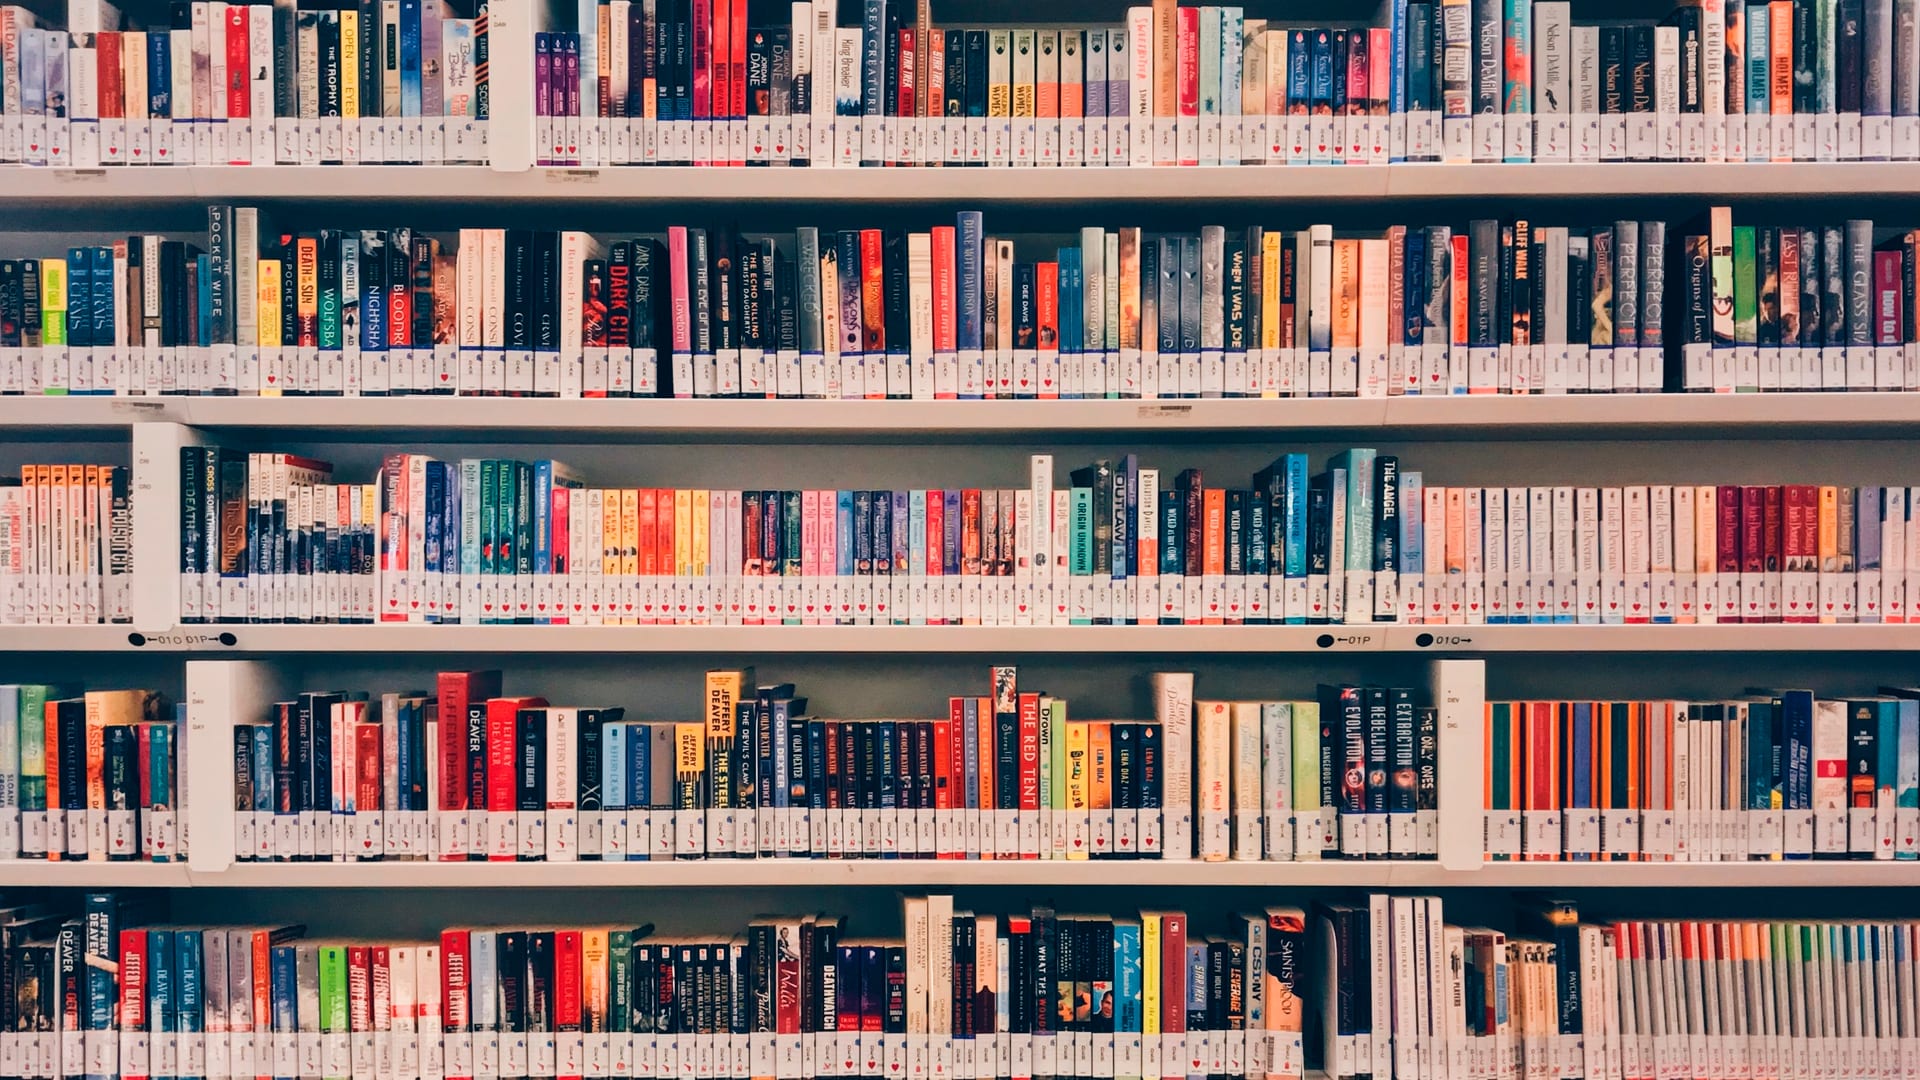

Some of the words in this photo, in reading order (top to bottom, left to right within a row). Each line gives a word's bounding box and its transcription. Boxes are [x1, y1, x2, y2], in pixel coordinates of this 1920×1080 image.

[4, 10, 15, 31] BILL
[364, 13, 372, 43] Fallen
[868, 7, 877, 32] SEA
[1751, 10, 1765, 58] WARLOCK
[4, 34, 15, 63] DALY
[345, 29, 355, 58] OPEN
[838, 39, 854, 56] King
[1480, 20, 1498, 55] Nelson
[1546, 23, 1560, 51] Nelson
[364, 47, 372, 80] Women
[677, 44, 685, 65] Dane
[750, 53, 761, 86] DANE
[773, 45, 783, 80] DANE
[903, 50, 913, 69] STAR
[933, 50, 942, 69] STAR
[1546, 54, 1560, 86] DeMille
[1707, 23, 1722, 86] CRUCIBLE
[328, 63, 336, 105] TROPHY
[842, 58, 854, 88] Breaker
[868, 39, 877, 114] CREATURE
[903, 70, 913, 88] TREK
[933, 70, 942, 89] TREK
[1480, 59, 1498, 99] DeMille
[1751, 60, 1765, 99] HOLMES
[345, 87, 355, 115] EYES
[991, 86, 1001, 117] WOMEN
[1016, 86, 1025, 117] WOMEN
[212, 212, 221, 272] POCKET
[1516, 220, 1528, 248] CLIFF
[1783, 234, 1797, 265] LAST
[302, 246, 315, 275] DEATH
[1393, 232, 1402, 269] LYDIA
[1516, 250, 1528, 279] WALK
[1232, 251, 1243, 282] WHEN
[1691, 255, 1704, 300] Origins
[212, 280, 221, 317] WIFE
[285, 263, 293, 311] POCKET
[302, 284, 315, 304] SUN
[1393, 273, 1402, 309] DAVIS
[1620, 242, 1635, 326] PERFECT
[1646, 243, 1661, 326] PERFECT
[1853, 270, 1867, 317] GLASS
[323, 288, 335, 347] WOLFSBA
[743, 289, 751, 335] DAUGHERTY
[1232, 292, 1243, 320] WAS
[1693, 302, 1705, 313] of
[1882, 290, 1896, 317] how
[285, 313, 293, 340] WIFE
[676, 298, 686, 343] Lovetorn
[751, 302, 759, 339] KILLING
[1230, 323, 1243, 347] JOE
[1694, 315, 1703, 342] Love
[1883, 320, 1896, 333] to
[206, 465, 214, 491] CROSS
[1383, 461, 1395, 482] THE
[186, 489, 196, 529] DEATH
[1076, 503, 1087, 530] ORIGIN
[1114, 475, 1125, 542] OUTLAW
[1252, 507, 1263, 528] WICKED
[1383, 484, 1395, 520] ANGEL
[1489, 505, 1503, 527] Jude
[1511, 505, 1525, 527] Jude
[1582, 506, 1595, 527] Jude
[1655, 500, 1669, 521] Jude
[112, 509, 127, 548] POISON
[1655, 523, 1669, 565] Deveraux
[112, 552, 127, 574] CIT
[1076, 532, 1087, 571] UNKNOWN
[1489, 529, 1503, 570] Deveraux
[1511, 529, 1525, 570] Deveraux
[1582, 530, 1595, 571] Deveraux
[186, 636, 208, 645] 01P
[1348, 636, 1371, 644] 01P
[300, 709, 309, 737] Home
[711, 690, 720, 732] DEAVER
[720, 689, 730, 733] JEFFERY
[742, 710, 750, 727] THE
[1023, 701, 1036, 728] THE
[1041, 707, 1051, 745] Drown
[491, 720, 502, 765] DEAVER
[503, 720, 512, 766] JEFFERY
[775, 713, 785, 744] COLIN
[792, 734, 803, 753] COLIN
[1345, 706, 1362, 762] EVOLUTION
[1370, 706, 1387, 762] REBELLION
[1395, 703, 1413, 765] EXTRACTION
[300, 739, 309, 762] Fires
[556, 730, 567, 765] JEFFERY
[742, 730, 750, 759] DEVIL'S
[1023, 735, 1036, 761] RED
[718, 751, 729, 773] THE
[742, 762, 750, 784] CLAW
[775, 747, 785, 788] DEXTER
[792, 754, 803, 778] DEXTER
[6, 774, 14, 805] SLOANE
[556, 768, 567, 799] DEAVER
[718, 775, 729, 807] STEEL
[1023, 768, 1036, 805] TENT
[1041, 774, 1051, 806] Junot
[99, 912, 108, 956] JEFFERY
[62, 930, 74, 972] DEAVER
[1037, 946, 1047, 974] WHAT
[1214, 951, 1222, 973] SLEEPY
[125, 952, 140, 986] JEFFERY
[448, 952, 463, 988] JEFFERY
[184, 969, 195, 1005] DEAVER
[780, 968, 797, 1009] Wallis
[823, 965, 835, 1030] DEATHWATCH
[1037, 977, 1047, 995] THE
[1231, 968, 1241, 1012] LEVERAGE
[1453, 982, 1462, 1007] PLAYERS
[1568, 971, 1577, 1012] PAYCHECK
[449, 990, 465, 1021] DEAVER
[753, 991, 771, 1026] Palace
